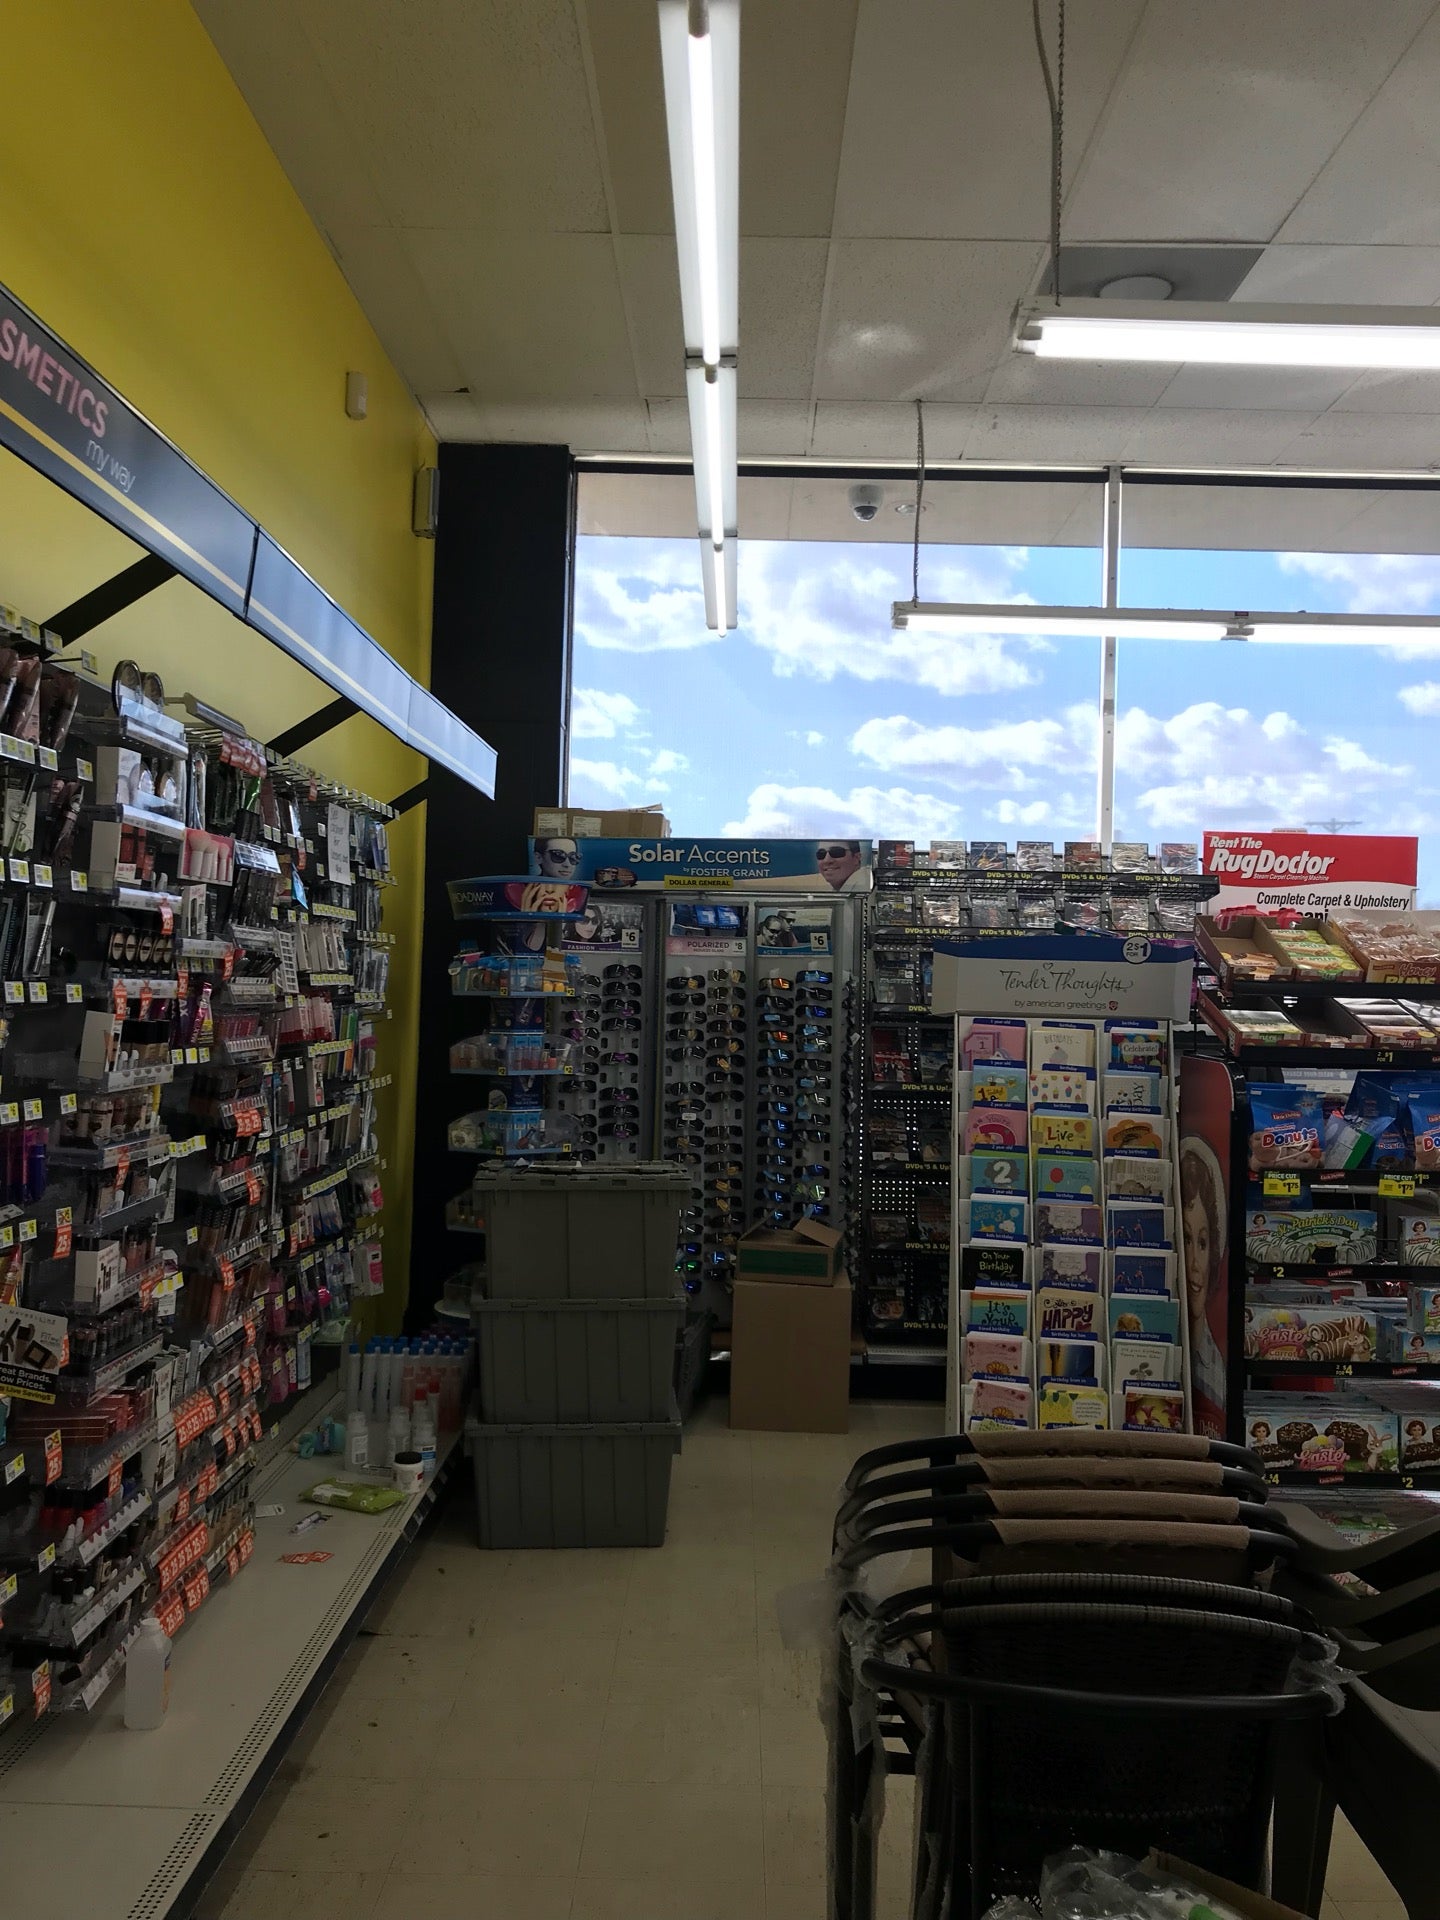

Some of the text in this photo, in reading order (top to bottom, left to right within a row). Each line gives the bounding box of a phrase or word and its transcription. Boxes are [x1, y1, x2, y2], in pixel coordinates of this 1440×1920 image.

[0, 319, 108, 437] SMETICS
[86, 440, 135, 492] my way
[1210, 836, 1262, 849] Rent The
[629, 843, 769, 864] Solar Accents
[691, 868, 729, 876] FOSTER
[733, 869, 770, 877] GRANT
[1257, 892, 1409, 910] Complete Carpet & Upholstery
[626, 932, 635, 942] $6
[814, 935, 824, 946] $6
[1127, 943, 1133, 951] 2
[1400, 963, 1437, 977] Honey
[1000, 968, 1134, 998] Tender Thoughts
[1015, 999, 1107, 1011] by american greetings
[1048, 1127, 1074, 1142] Live
[1262, 1128, 1317, 1147] Donuts
[993, 1161, 1012, 1184] 2
[1291, 1213, 1335, 1229] Patrick's
[1337, 1216, 1358, 1229] Day
[979, 1262, 1014, 1272] Birthday
[1273, 1266, 1285, 1277] $2
[1043, 1304, 1093, 1330] HAPPY
[1254, 1327, 1310, 1344] Easter
[19, 1371, 52, 1383] Brands.
[17, 1379, 46, 1390] Prices.
[1295, 1449, 1350, 1462] Easter
[1402, 1477, 1413, 1488] $2
